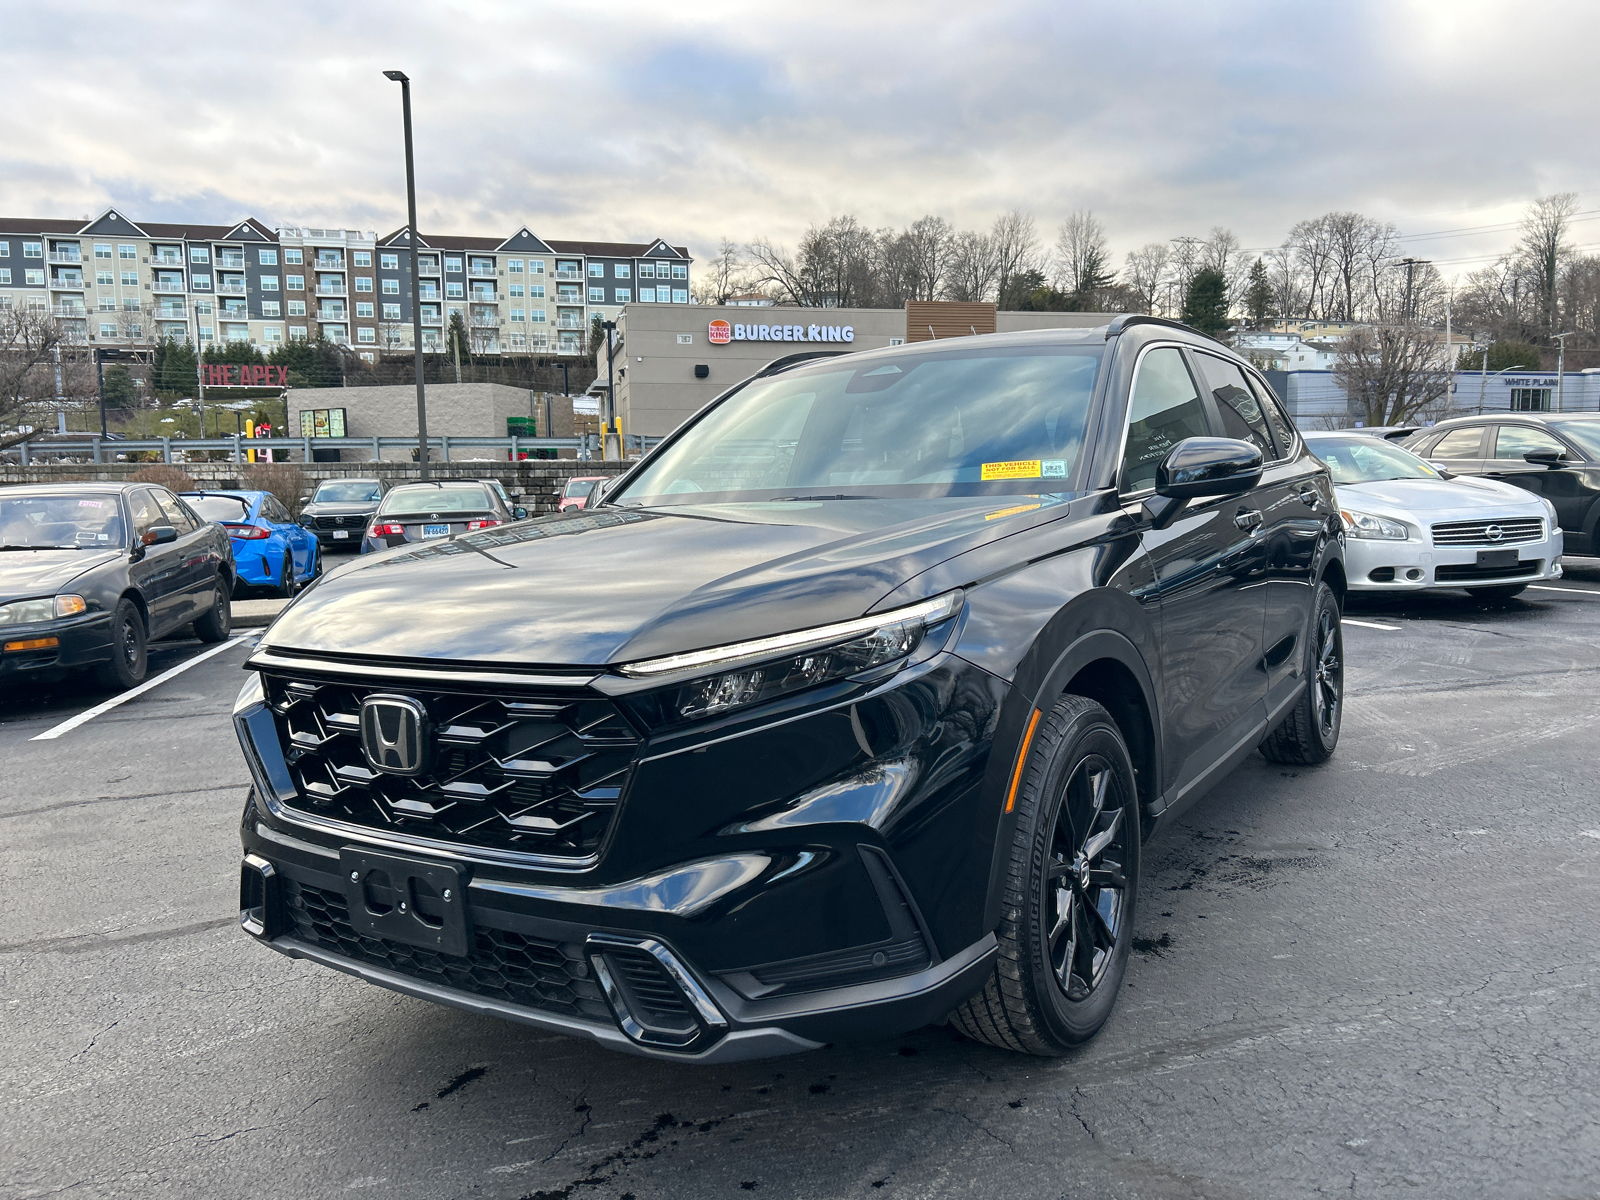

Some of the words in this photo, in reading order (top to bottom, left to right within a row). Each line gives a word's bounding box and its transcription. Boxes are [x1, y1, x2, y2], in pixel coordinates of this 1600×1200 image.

[734, 324, 804, 341] BURGER
[807, 325, 854, 342] KING
[196, 364, 233, 385] THE
[239, 365, 289, 387] APEX
[1505, 378, 1531, 386] WHITE
[1532, 379, 1558, 387] PLAIN
[1030, 816, 1048, 972] BRIDGESTONE
